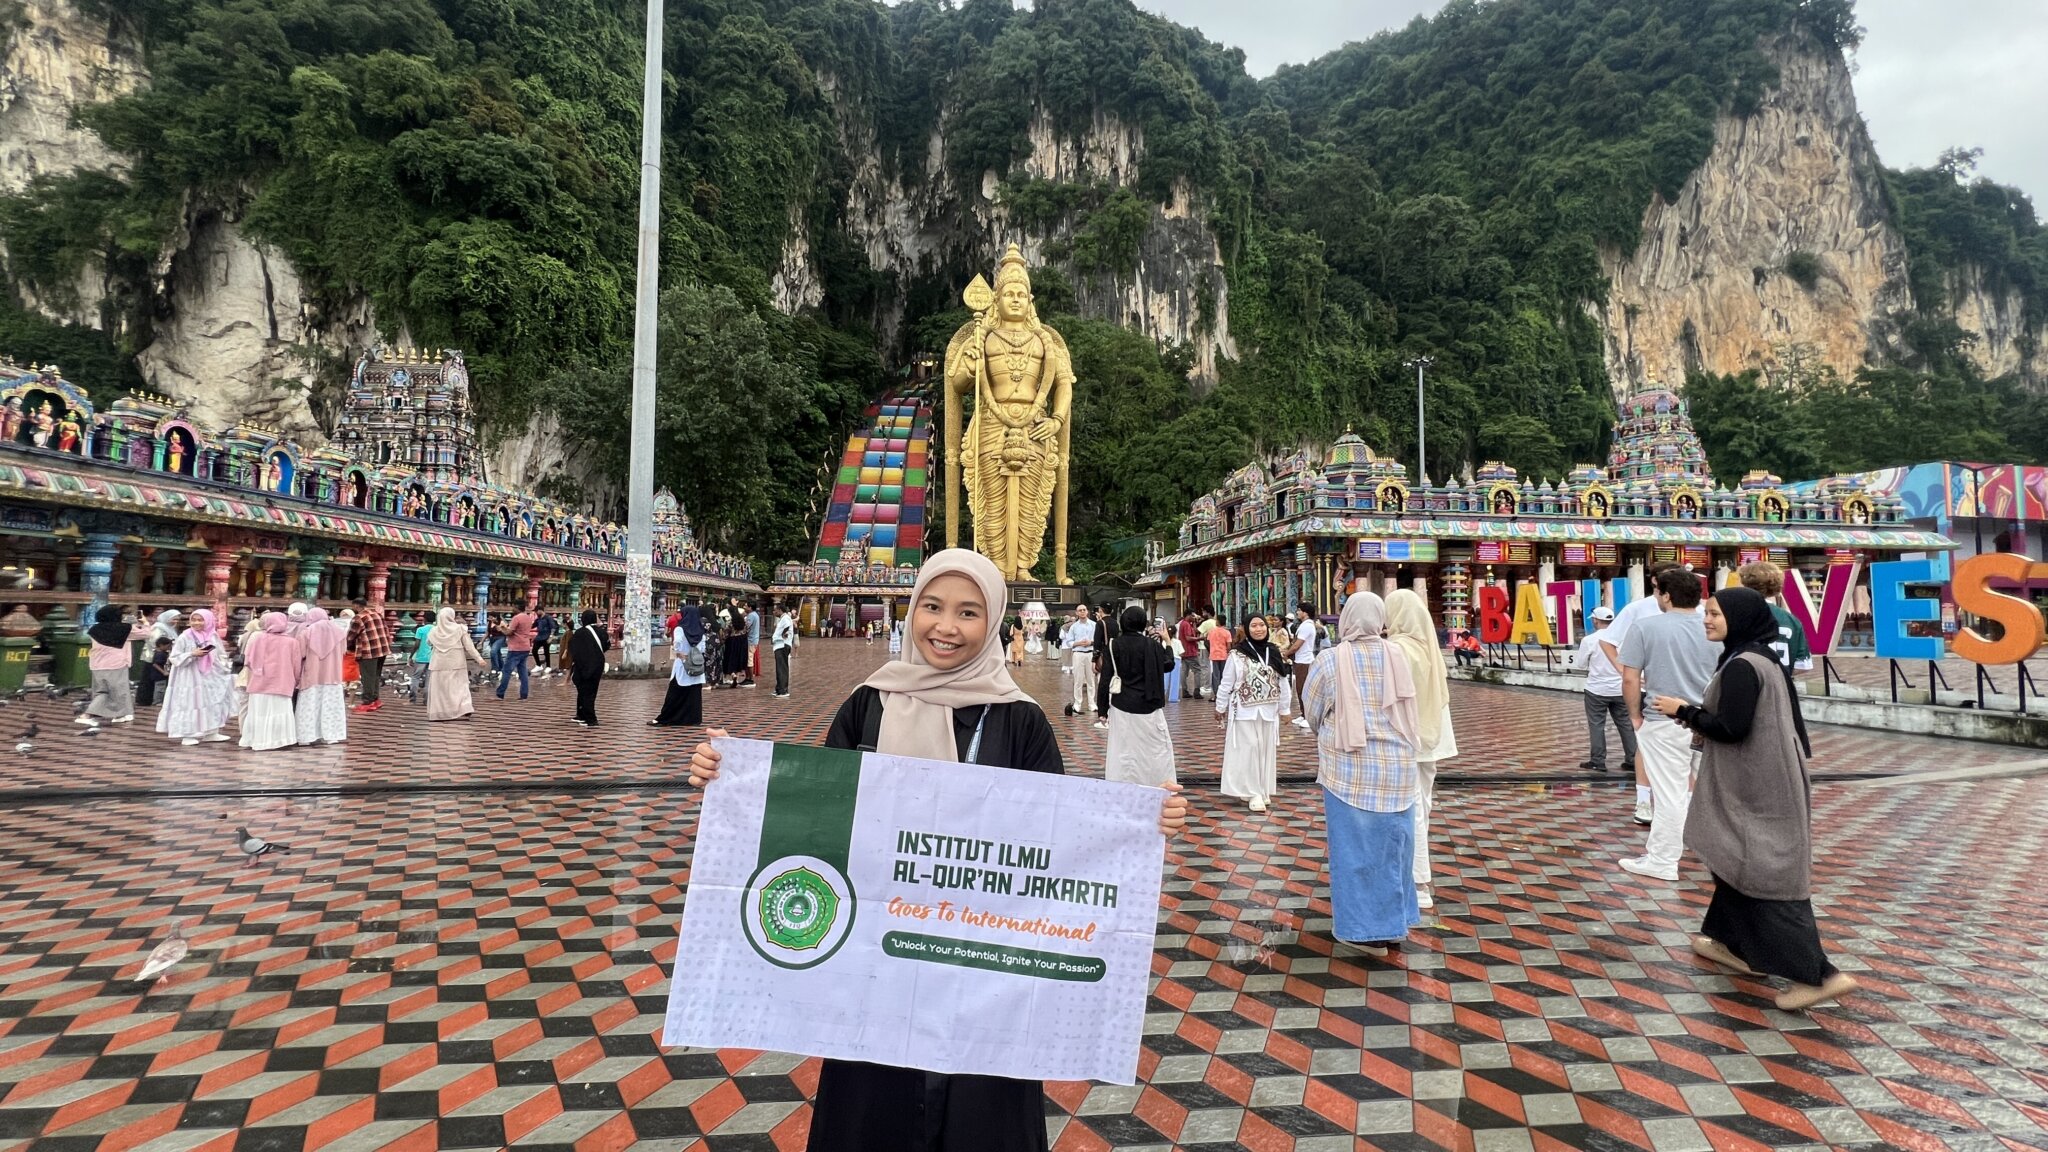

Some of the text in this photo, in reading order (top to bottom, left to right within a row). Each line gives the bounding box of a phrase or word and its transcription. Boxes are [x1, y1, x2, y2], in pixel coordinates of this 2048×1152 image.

[1693, 553, 2045, 665] VES
[896, 830, 1051, 871] INSTITUT ILMU
[893, 860, 1118, 909] AL-QUR'AN JAKARTA
[887, 896, 1097, 942] Goes To International
[891, 938, 1100, 974] "Unlock Your Potential, Ignite Your Passion"
